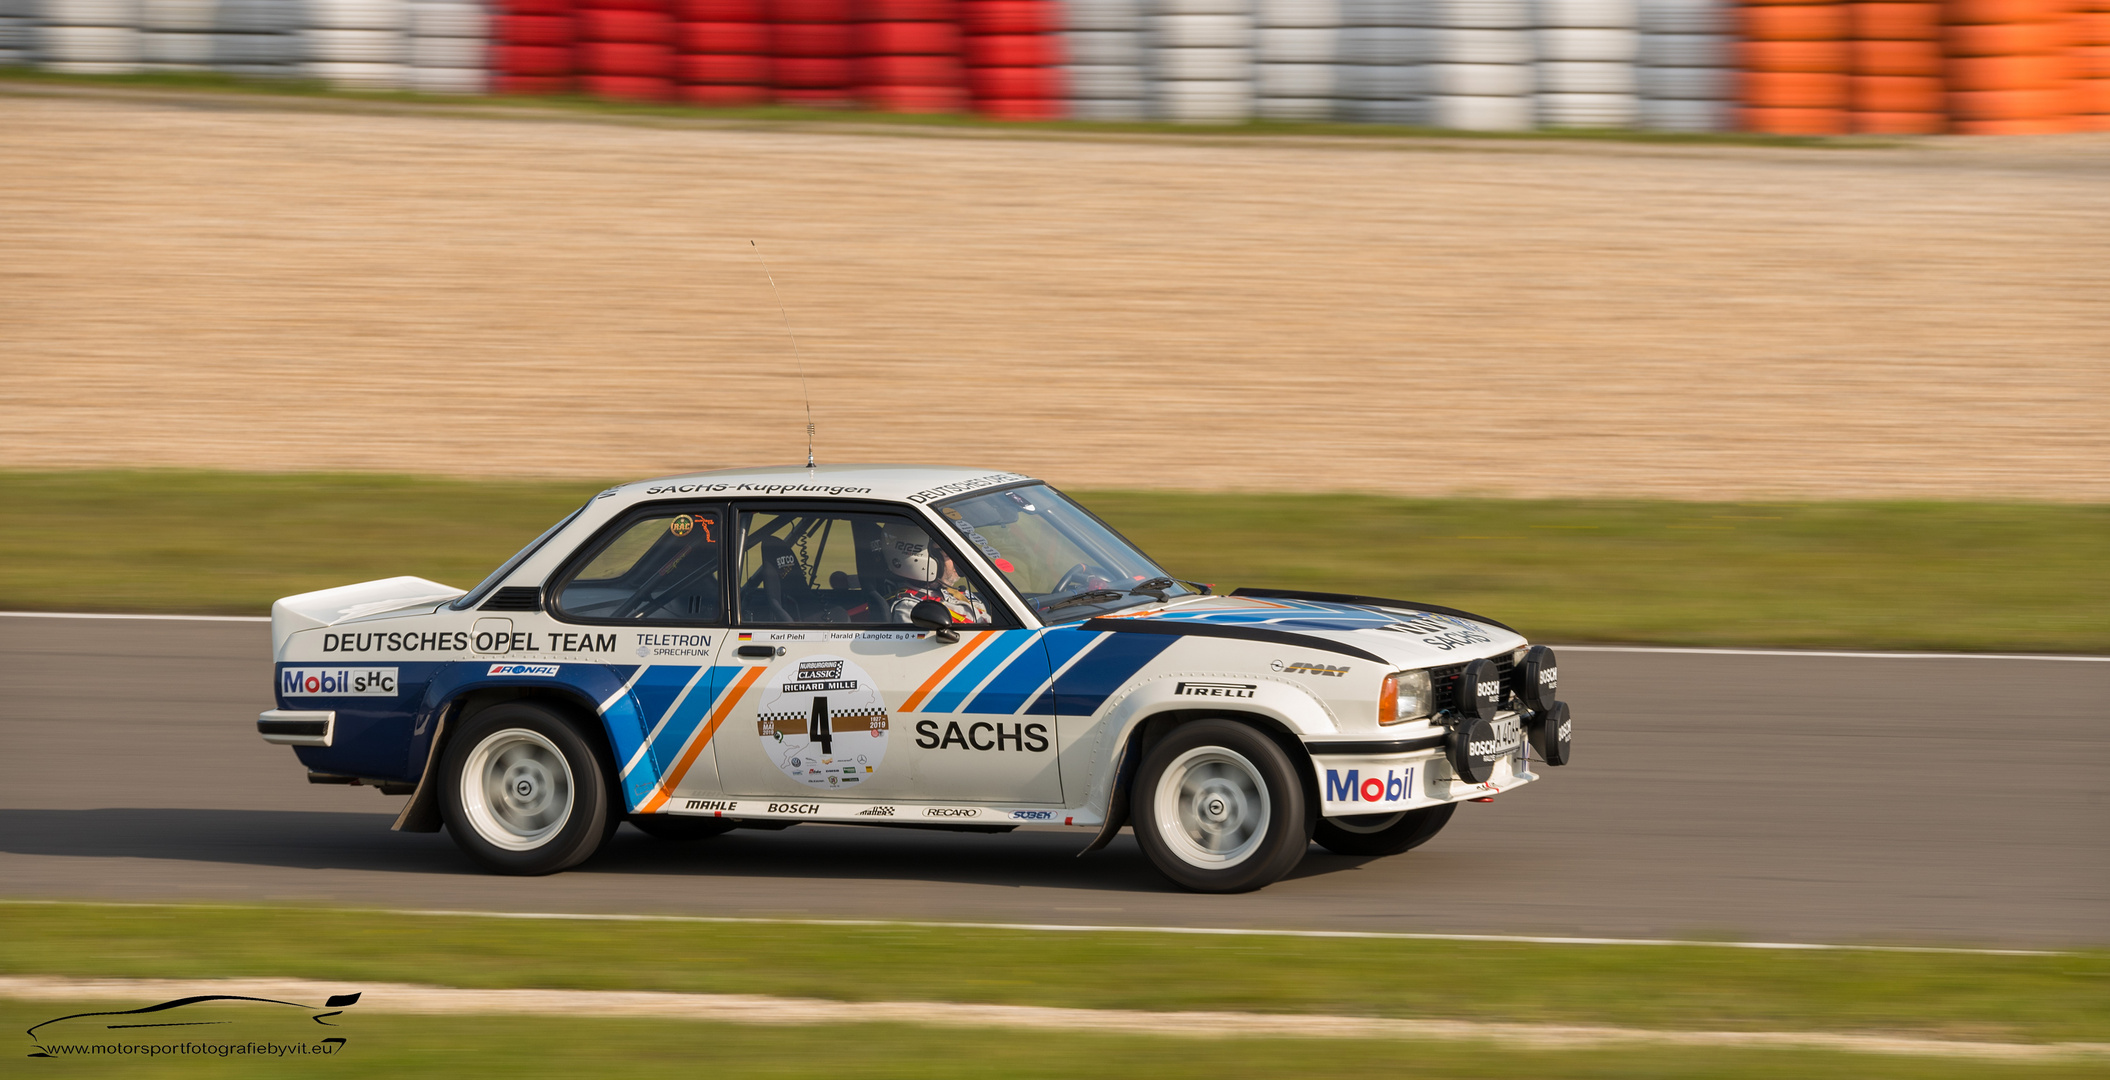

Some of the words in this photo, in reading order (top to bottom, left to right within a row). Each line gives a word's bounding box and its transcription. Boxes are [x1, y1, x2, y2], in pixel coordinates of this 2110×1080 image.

[646, 483, 872, 495] SACHS-Kupplungen
[323, 632, 468, 652] DEUTSCHES
[475, 632, 540, 652] OPEL
[548, 633, 617, 652] TEAM
[636, 634, 712, 647] TELETRON
[862, 633, 892, 641] Langlotz
[653, 648, 710, 657] SPRECHFUNK
[798, 670, 836, 679] CLASSIC
[1284, 662, 1351, 677] SPORT
[1540, 667, 1557, 684] BOSCH
[284, 671, 349, 693] Mobil
[784, 683, 824, 692] RICHARD
[828, 681, 856, 690] MILLE
[1477, 680, 1500, 697] BOSCH
[1174, 682, 1257, 698] PIRELLI
[810, 696, 832, 754] 4
[870, 721, 886, 729] 2019
[915, 720, 1049, 752] SACHS
[1469, 740, 1496, 756] BOSCH
[1326, 767, 1414, 802] Mobil
[685, 800, 737, 811] MAHLE
[767, 803, 820, 814] BOSCH
[927, 808, 976, 817] RECARO
